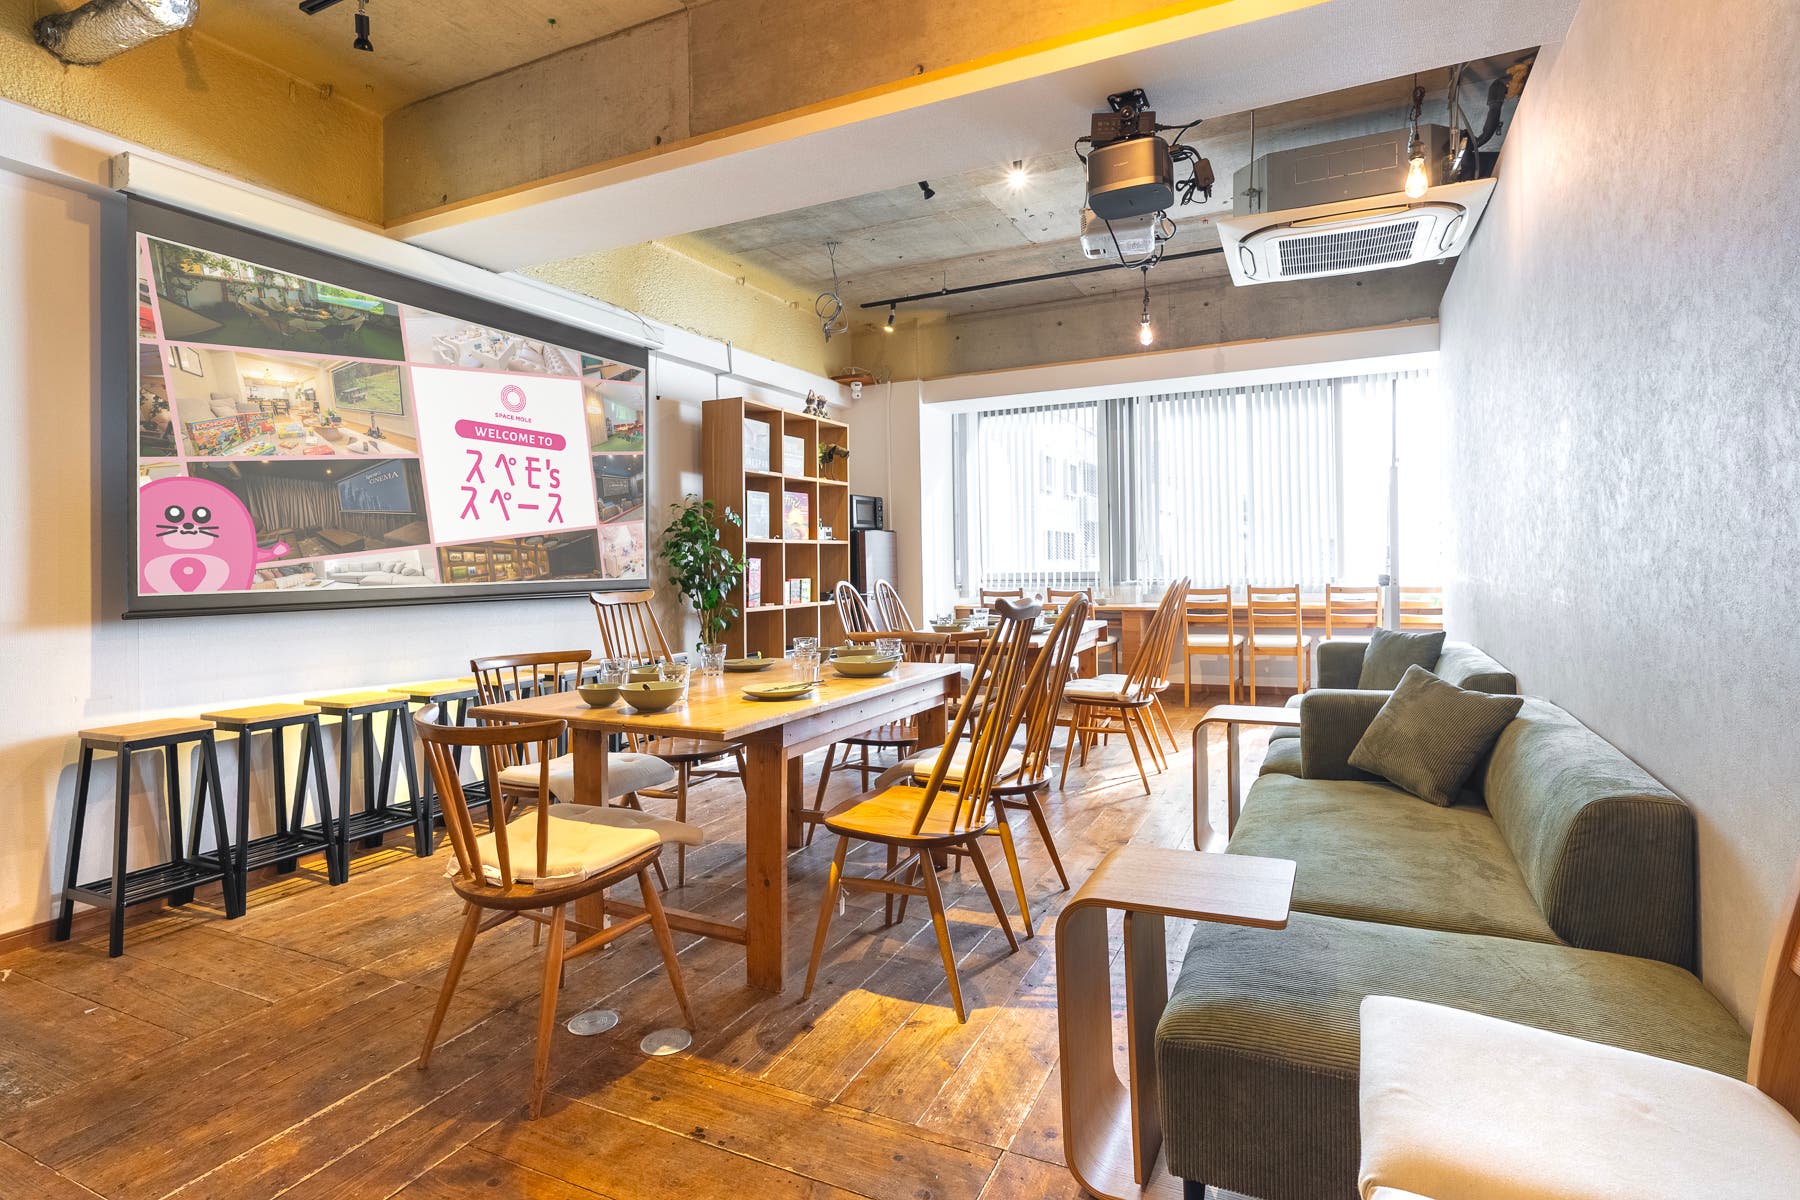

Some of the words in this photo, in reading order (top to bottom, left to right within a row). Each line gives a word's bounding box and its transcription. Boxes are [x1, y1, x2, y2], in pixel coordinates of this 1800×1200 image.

[494, 412, 514, 420] SPACE
[515, 415, 532, 423] MOLE
[474, 426, 536, 444] WELCOME
[537, 435, 553, 447] TO
[465, 449, 561, 489] スペモ's
[460, 486, 564, 524] スペース
